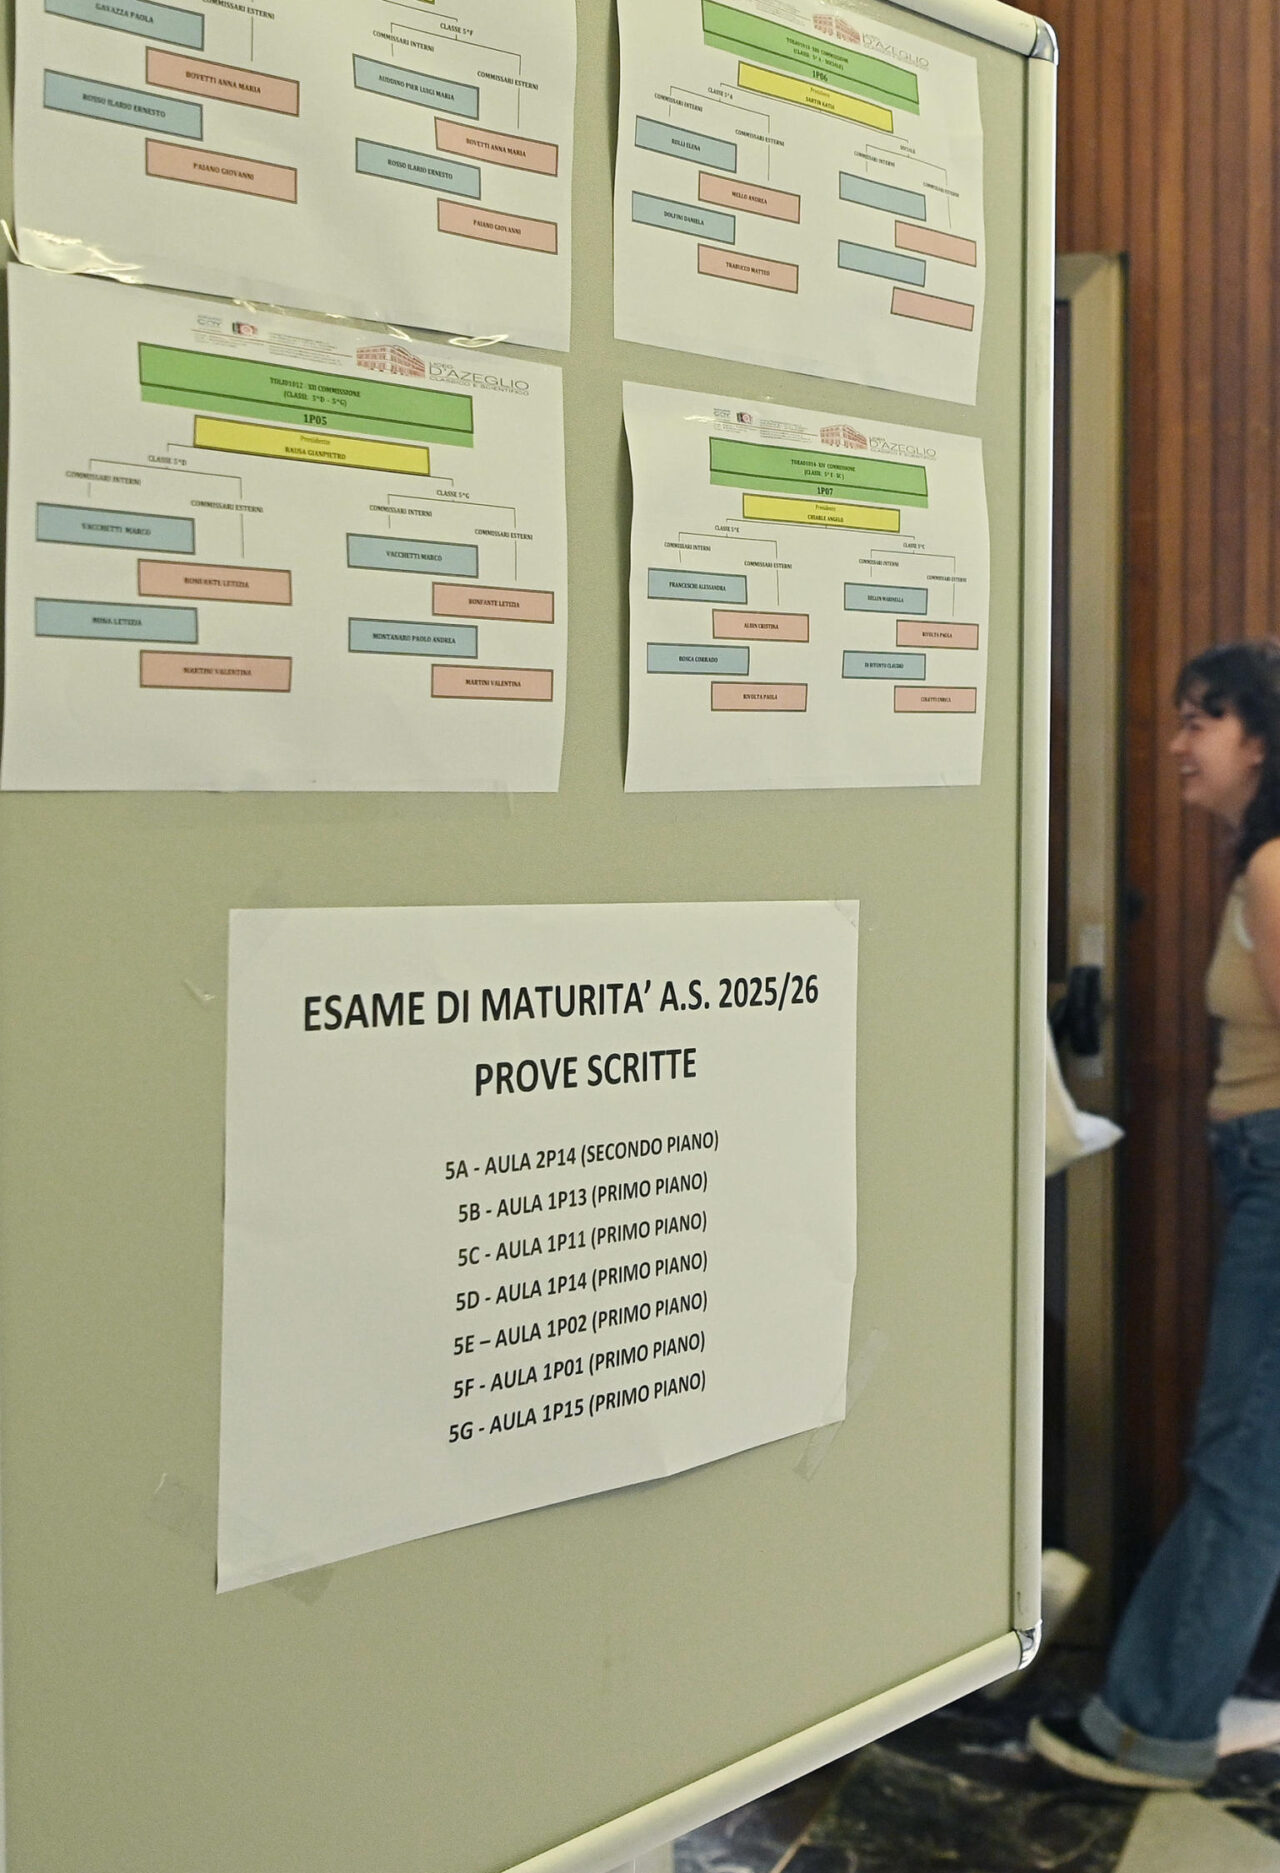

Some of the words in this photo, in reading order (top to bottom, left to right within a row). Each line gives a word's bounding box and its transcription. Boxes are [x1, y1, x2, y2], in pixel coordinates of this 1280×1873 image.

[440, 22, 461, 34] CLASSE
[373, 30, 409, 46] COMMISSARI
[410, 40, 434, 52] INTERNI
[218, 78, 237, 89] ANNA
[239, 82, 261, 94] MARIA
[477, 70, 513, 84] COMMISSARI
[515, 79, 538, 90] ESTERNI
[406, 83, 418, 92] PIER
[420, 86, 434, 96] LUIGI
[436, 90, 454, 101] MARIA
[134, 105, 166, 118] ERNESTO
[491, 144, 507, 153] ANNA
[507, 147, 526, 157] MARIA
[221, 168, 254, 180] GIOVANNI
[408, 163, 426, 174] ILARIO
[428, 169, 453, 180] ERNESTO
[495, 223, 521, 235] GIOVANNI
[429, 365, 529, 390] D'AZEGLIO
[304, 413, 327, 426] 1P05
[437, 490, 457, 498] CLASSE
[817, 487, 833, 496] 1P07
[369, 505, 406, 515] COMMISSARI
[407, 509, 432, 517] INTERNI
[475, 529, 509, 538] COMMISSARI
[510, 532, 533, 540] ESTERNI
[412, 635, 431, 643] PAOLO
[490, 680, 521, 688] VALENTINA
[304, 992, 424, 1031] ESAME
[438, 990, 469, 1023] DI
[660, 980, 709, 1011] A.S.
[719, 972, 818, 1011] 2025/26
[476, 1058, 577, 1096] PROVE
[588, 1048, 696, 1085] SCRITTE
[445, 1160, 469, 1180] 5A
[485, 1153, 531, 1175] AULA
[536, 1147, 576, 1169] 2P14
[581, 1138, 662, 1167] (SECONDO
[668, 1130, 719, 1153] PIANO)
[459, 1203, 480, 1223] 5B
[497, 1195, 542, 1217] AULA
[549, 1189, 587, 1210] 1P13
[592, 1180, 650, 1208] (PRIMO
[656, 1171, 708, 1195] PIANO)
[458, 1247, 479, 1266] 5C
[496, 1238, 542, 1261] AULA
[548, 1231, 586, 1253] 1P11
[591, 1222, 649, 1249] (PRIMO
[656, 1211, 707, 1235] PIANO)
[456, 1291, 479, 1311] 5D
[496, 1280, 541, 1304] AULA
[548, 1273, 587, 1295] 1P14
[592, 1262, 650, 1291] (PRIMO
[656, 1251, 707, 1275] PIANO)
[454, 1335, 474, 1355] 5E
[495, 1323, 541, 1348] AULA
[547, 1315, 587, 1338] 1P02
[592, 1303, 650, 1333] (PRIMO
[656, 1290, 707, 1316] PIANO)
[454, 1379, 474, 1399] 5F
[491, 1366, 537, 1391] AULA
[544, 1358, 583, 1381] 1P01
[590, 1345, 648, 1375] (PRIMO
[653, 1331, 705, 1358] PIANO)
[449, 1422, 473, 1443] 5G
[490, 1408, 536, 1434] AULA
[543, 1399, 583, 1422] 1P15
[589, 1385, 649, 1417] (PRIMO
[654, 1370, 706, 1399] PIANO)
